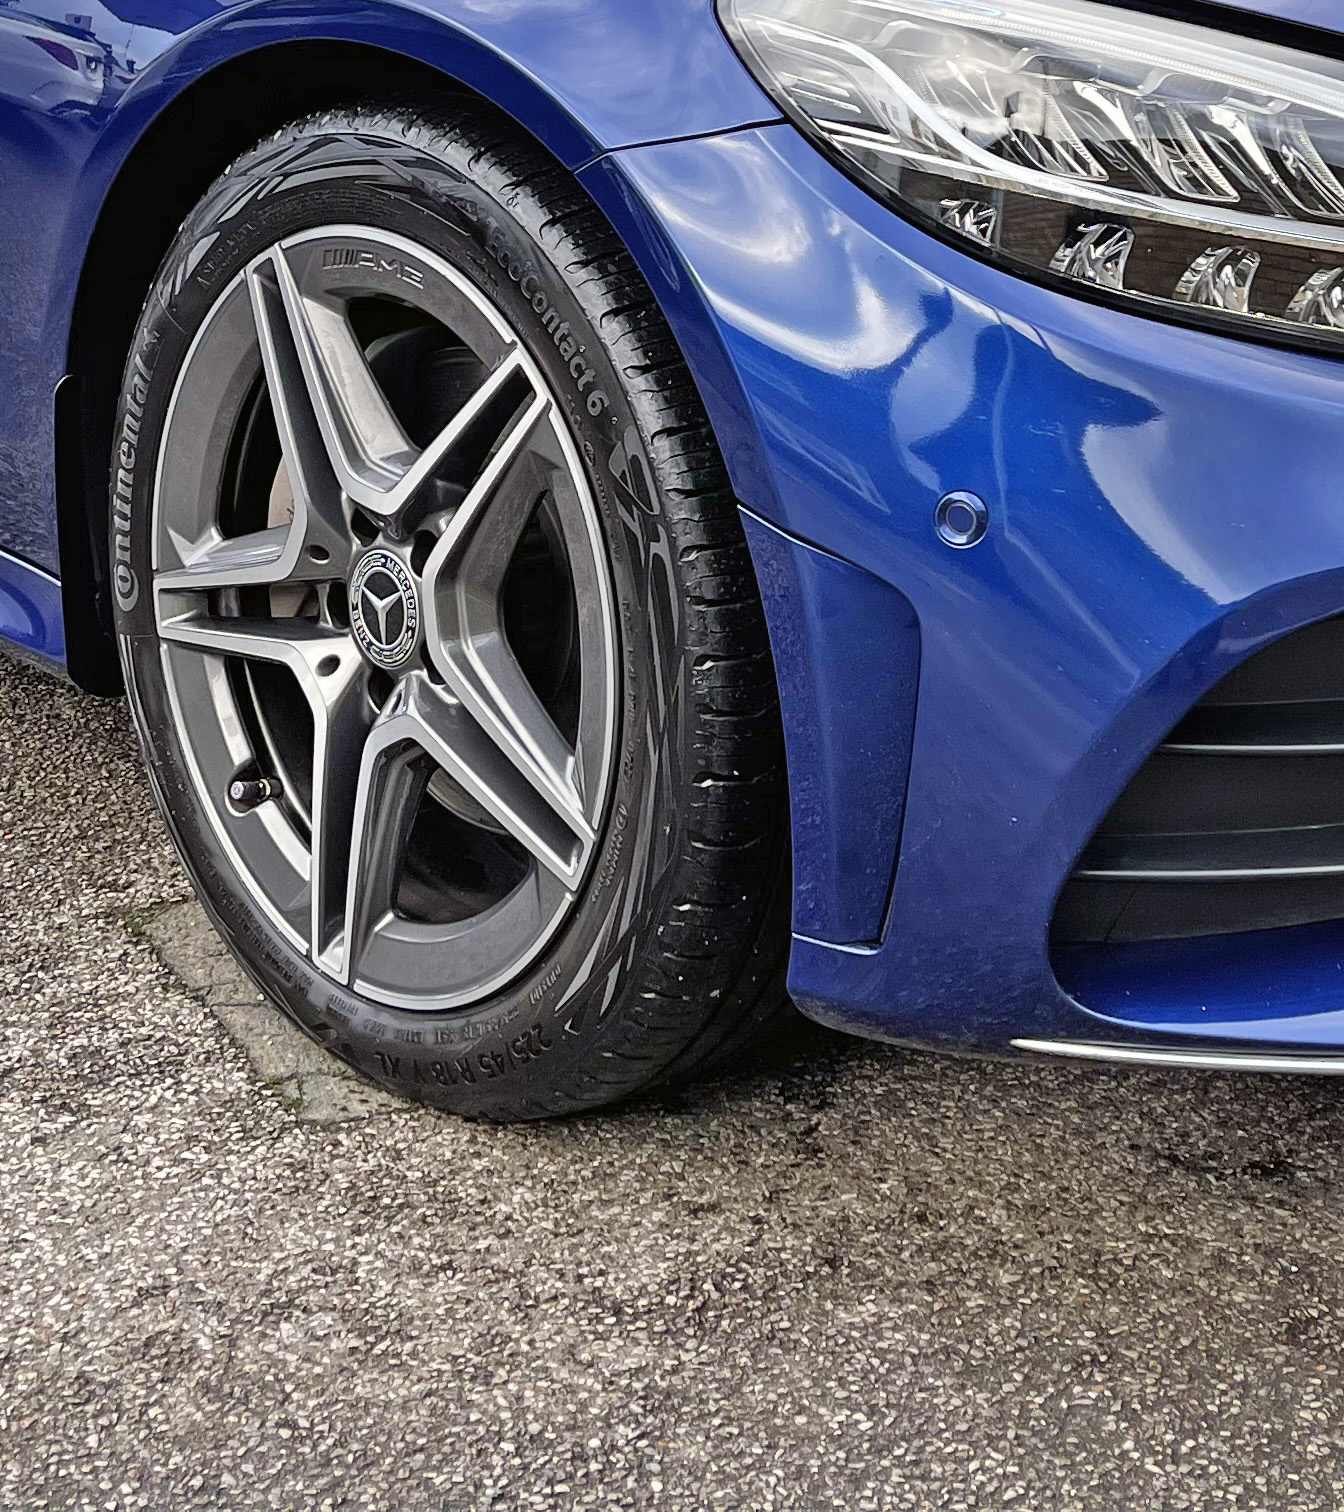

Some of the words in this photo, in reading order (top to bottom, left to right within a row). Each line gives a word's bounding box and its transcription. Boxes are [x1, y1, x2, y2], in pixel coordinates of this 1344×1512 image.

[587, 390, 610, 417] 6
[113, 353, 153, 612] Continental
[385, 557, 416, 629] MERCEDES
[352, 609, 371, 648] BENZ
